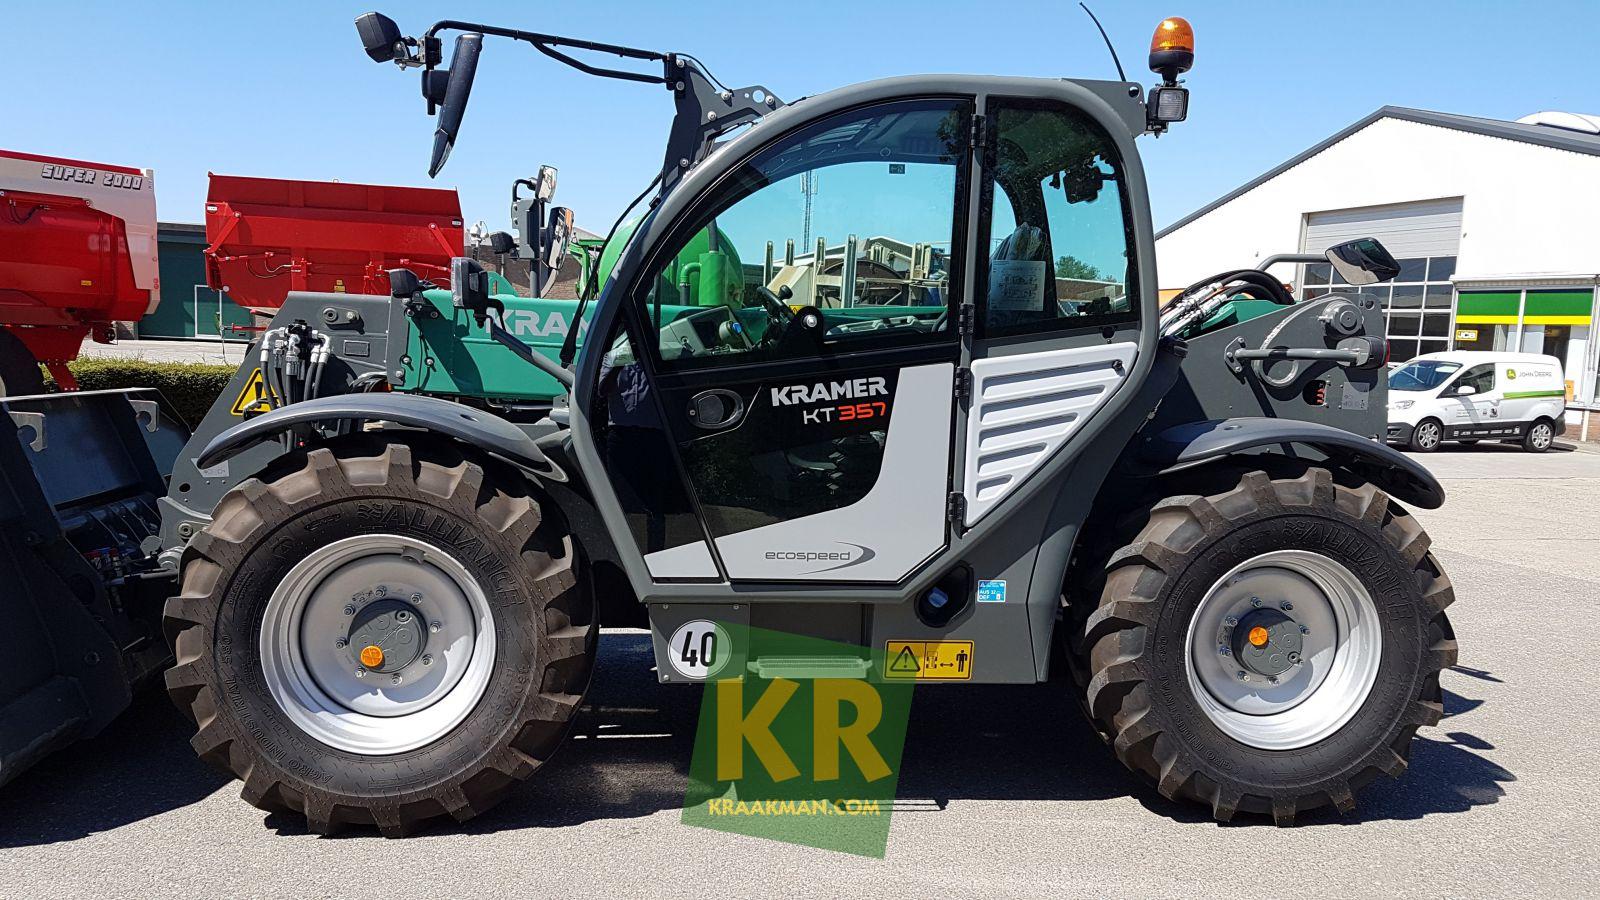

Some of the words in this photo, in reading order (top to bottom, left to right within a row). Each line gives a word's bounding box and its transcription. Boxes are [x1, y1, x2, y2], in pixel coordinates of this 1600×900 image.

[42, 164, 96, 184] SUPER
[103, 172, 142, 190] 2000
[771, 377, 888, 406] KRAMER
[380, 503, 525, 608] ALLIANCE
[765, 551, 851, 562] ecospeed
[681, 631, 718, 667] 40
